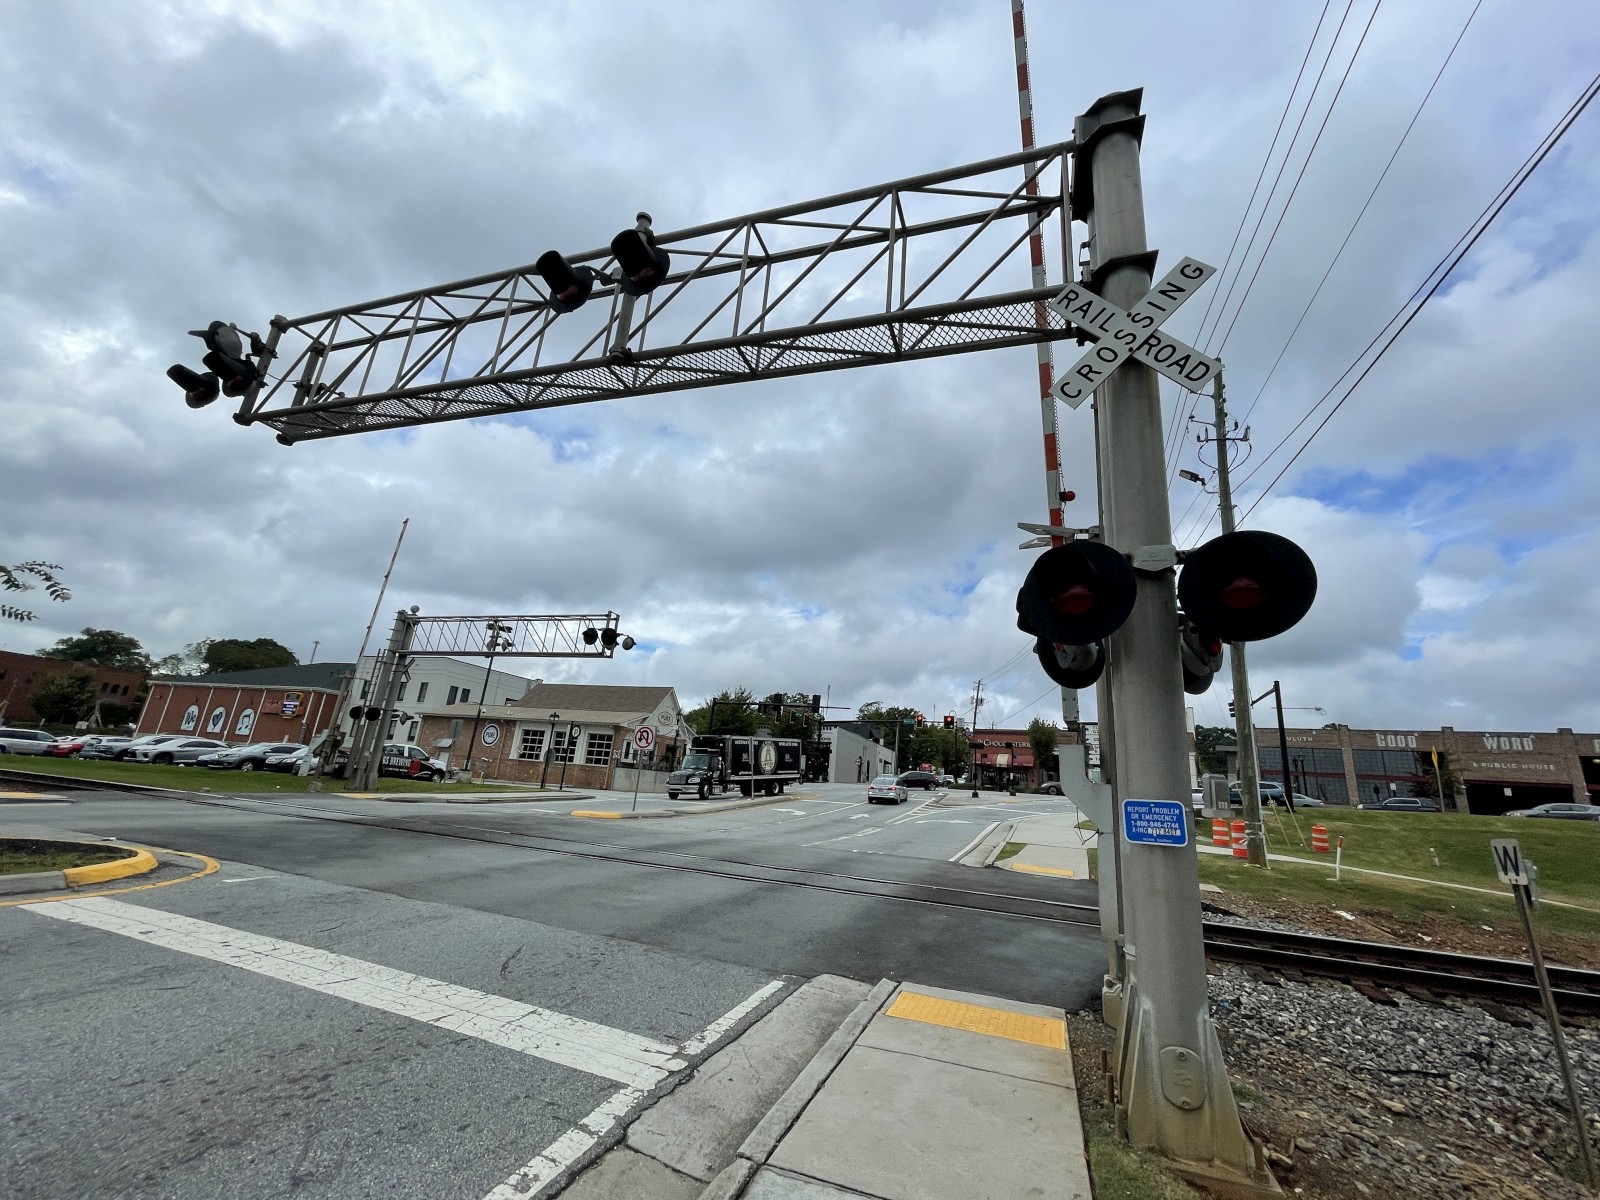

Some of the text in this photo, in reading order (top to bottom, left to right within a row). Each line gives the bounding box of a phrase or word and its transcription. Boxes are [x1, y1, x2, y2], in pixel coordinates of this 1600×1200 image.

[1057, 288, 1116, 333] RAIL
[1060, 263, 1204, 399] CROSSING
[1376, 734, 1533, 751] GOOD WORD
[1482, 761, 1517, 769] PUBLIC
[1493, 845, 1520, 876] W
